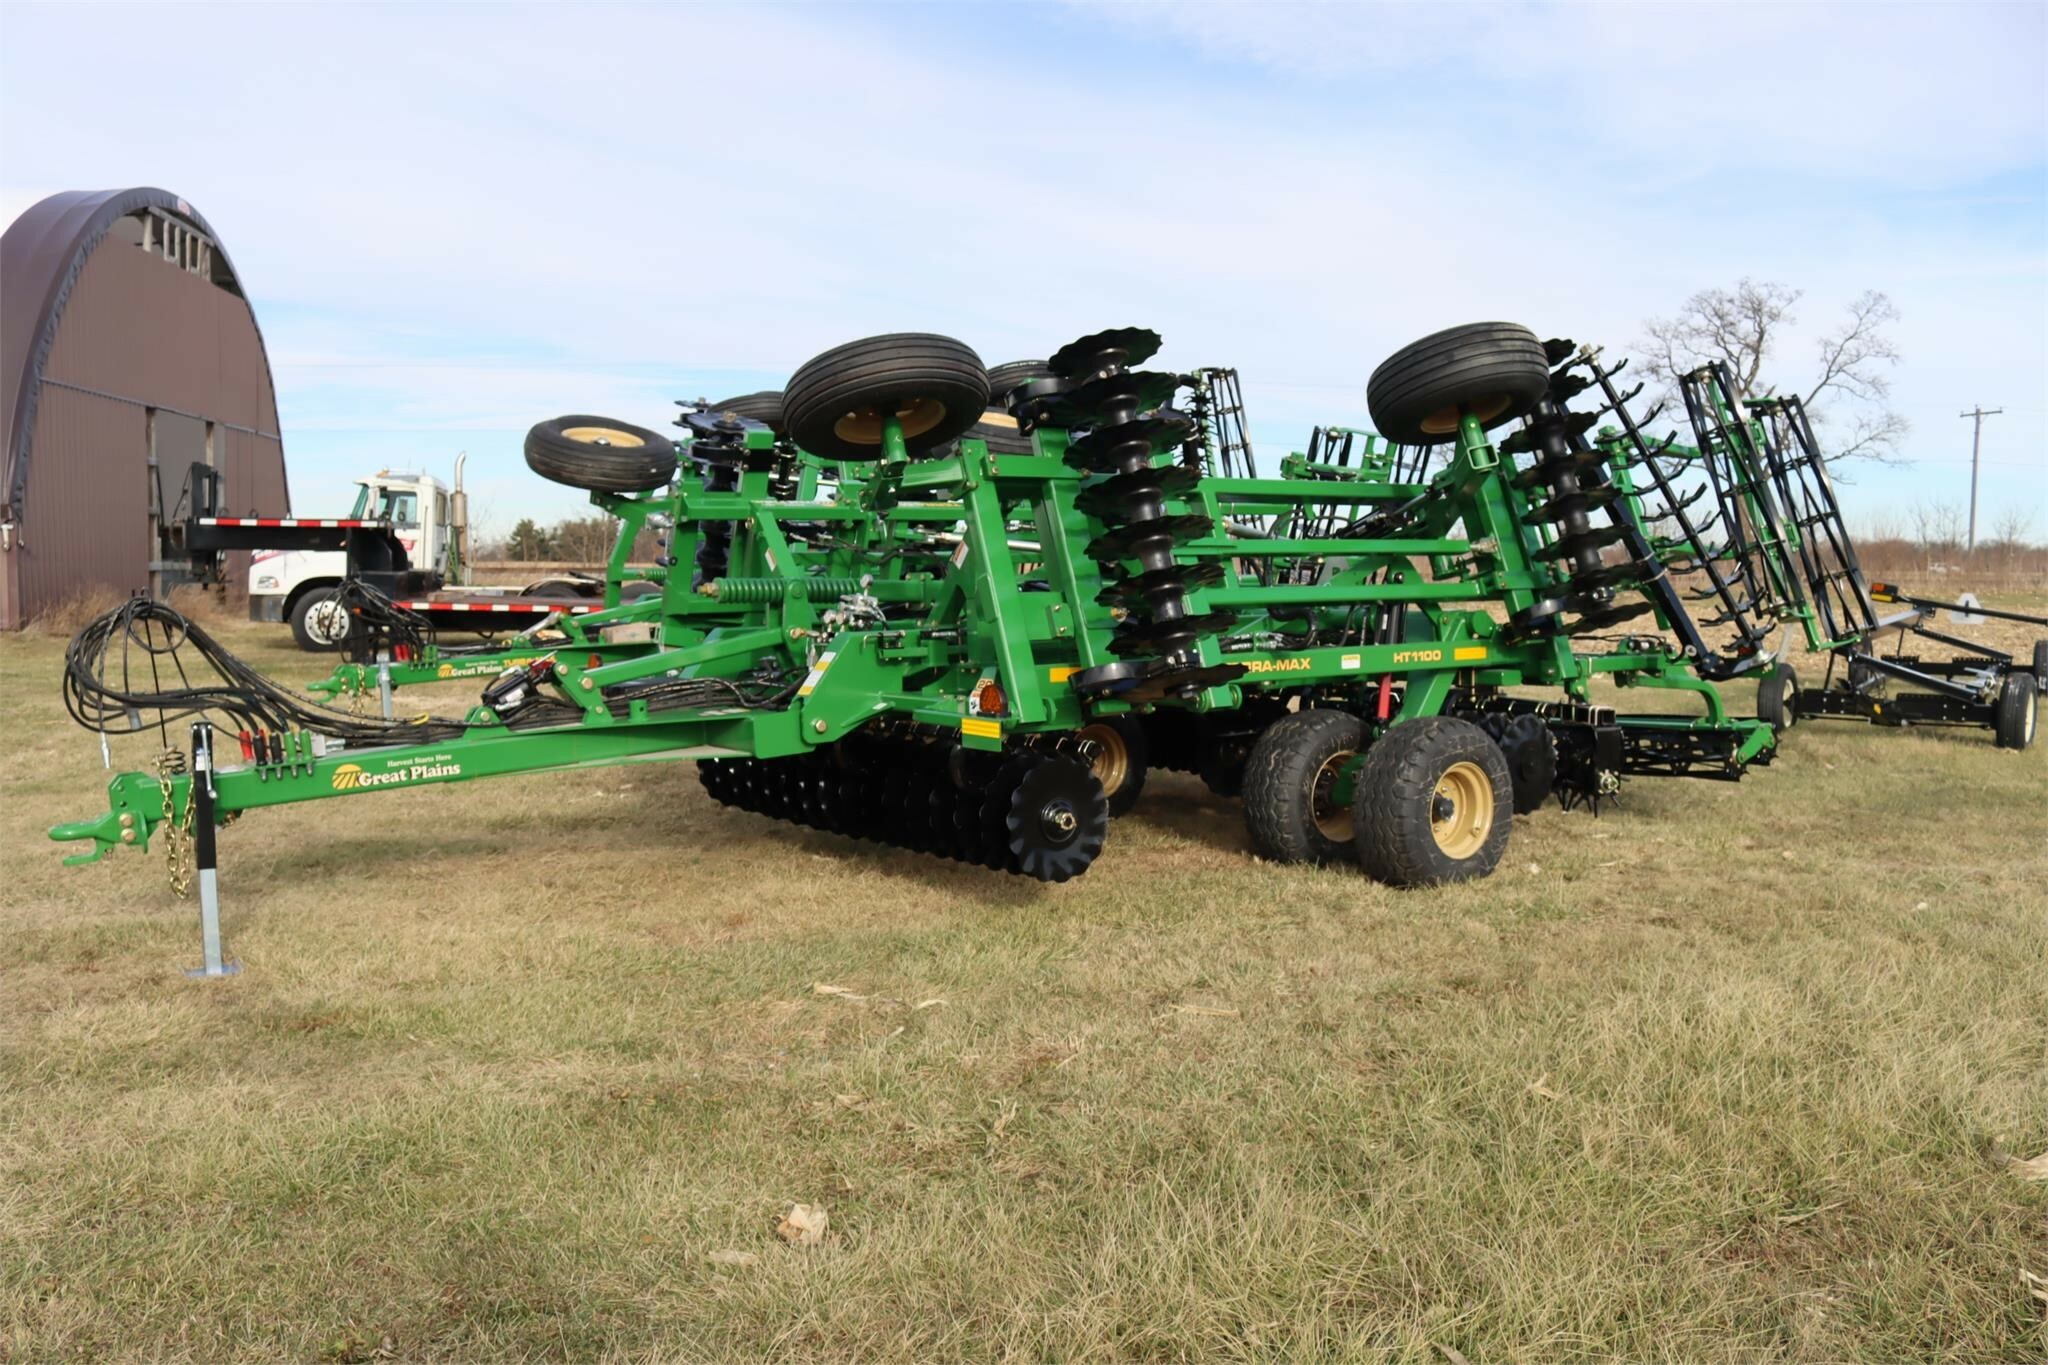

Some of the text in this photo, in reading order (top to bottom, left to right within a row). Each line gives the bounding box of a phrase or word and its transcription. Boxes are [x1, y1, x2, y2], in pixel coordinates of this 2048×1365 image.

[1393, 650, 1442, 663] HT1100
[452, 665, 503, 676] Great Plains
[1226, 658, 1311, 673] RA-MAX
[358, 763, 461, 786] Great Plains
